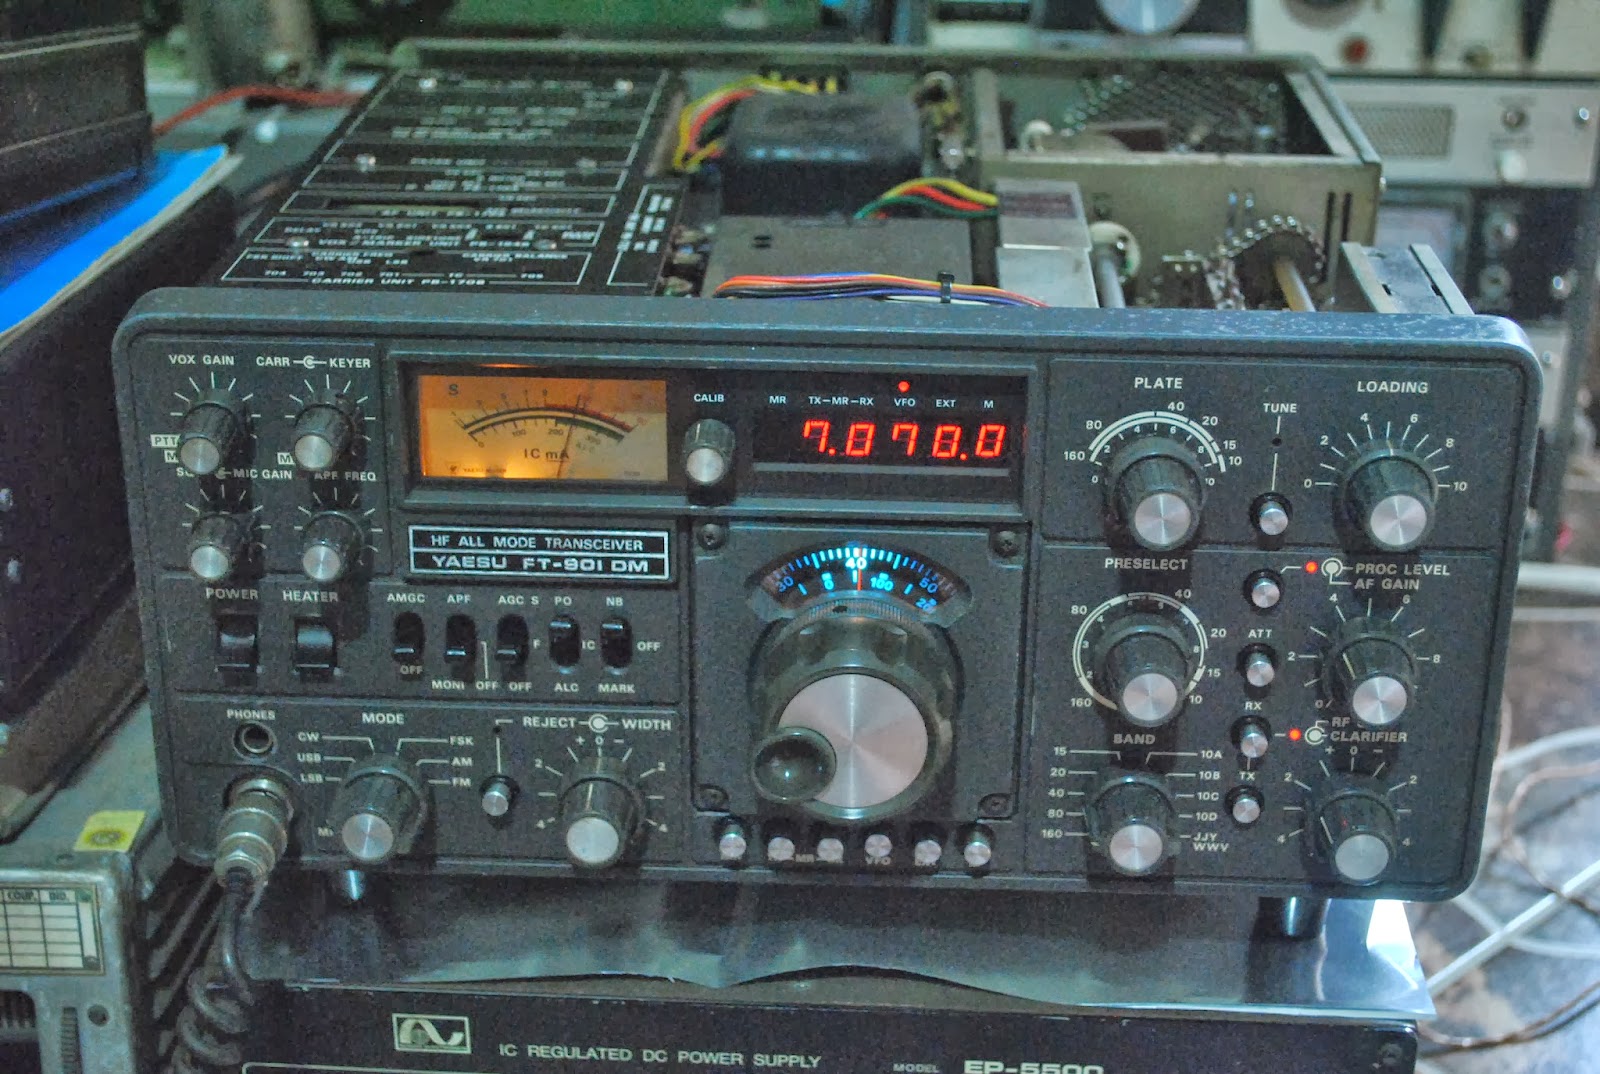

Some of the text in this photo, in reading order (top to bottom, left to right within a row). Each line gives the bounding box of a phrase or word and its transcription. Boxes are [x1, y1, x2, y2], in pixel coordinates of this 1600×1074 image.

[168, 354, 235, 366] VOX GAIN
[256, 356, 290, 367] CARR
[329, 358, 371, 369] KEYER
[1134, 377, 1183, 389] PLATE
[1357, 380, 1429, 394] LOADING
[448, 384, 459, 397] S
[694, 393, 724, 403] CALIB
[769, 395, 787, 404] MR
[894, 398, 916, 407] VFO
[936, 399, 956, 408] EXT
[984, 400, 994, 409] M
[1168, 401, 1185, 411] 40
[1263, 403, 1297, 413] TUNE
[1202, 416, 1218, 426] 20
[1360, 413, 1369, 423] 4
[1410, 413, 1419, 423] 6
[1086, 420, 1102, 430] 80
[1133, 426, 1141, 434] 4
[1170, 426, 1177, 434] 6
[154, 436, 177, 446] PTT
[1224, 440, 1237, 450] 15
[1320, 435, 1329, 446] 2
[1445, 438, 1454, 448] 8
[524, 447, 541, 459] IC
[1104, 445, 1111, 454] 2
[1063, 451, 1085, 461] 160
[1229, 456, 1242, 466] 10
[233, 469, 293, 481] MIC GAIN
[345, 471, 376, 482] FREQ
[1091, 475, 1098, 484] 0
[1303, 479, 1313, 489] 0
[1453, 481, 1468, 492] 10
[431, 534, 643, 551] HF ALL MODE TRANSCEIVER
[432, 555, 648, 573] YAESU FT-901 DM
[845, 557, 867, 570] 40
[1104, 558, 1188, 571] PRESELECT
[1355, 563, 1450, 576] PROC LEVEL
[775, 576, 794, 593] 30
[871, 577, 894, 592] 100
[919, 577, 939, 594] 50
[1354, 578, 1420, 590] AF GAIN
[206, 587, 258, 600] POWER
[283, 589, 338, 603] HEATER
[387, 593, 426, 604] AMGC
[1175, 589, 1192, 599] 40
[1329, 593, 1338, 603] 4
[447, 594, 471, 604] APF
[498, 595, 539, 605] AGC S
[554, 596, 572, 606] PO
[606, 597, 624, 607] NB
[1402, 595, 1411, 604] 6
[1071, 605, 1088, 616] 80
[1211, 628, 1227, 638] 20
[1248, 629, 1272, 638] ATT
[533, 639, 541, 649] F
[582, 640, 595, 650] IC
[637, 641, 661, 651] OFF
[1288, 652, 1296, 661] 2
[1433, 654, 1441, 663] 8
[400, 665, 423, 675] OFF
[1207, 668, 1221, 677] 15
[432, 681, 465, 691] MONI
[475, 681, 498, 691] OFF
[509, 681, 533, 691] OFF
[554, 682, 579, 693] ALC
[598, 683, 635, 694] MARK
[1070, 698, 1092, 708] 160
[1189, 695, 1203, 704] 10
[1245, 701, 1262, 710] RX
[227, 709, 275, 721] PHONES
[362, 713, 405, 725] MODE
[522, 716, 577, 728] REJECT
[622, 719, 672, 731] WIDTH
[1332, 717, 1350, 727] RF
[298, 732, 320, 742] CW
[449, 736, 474, 746] FSK
[595, 736, 604, 746] 0
[1113, 734, 1156, 745] BAND
[1330, 731, 1408, 743] CLARIFIER
[1054, 747, 1067, 756] 15
[1200, 750, 1223, 760] 10A
[297, 753, 321, 763] USB
[452, 757, 473, 767] AM
[534, 758, 543, 768] 2
[657, 762, 666, 772] 2
[1050, 768, 1067, 777] 20
[1199, 771, 1221, 780] 10B
[1239, 772, 1255, 781] TX
[1284, 773, 1292, 782] 2
[300, 774, 323, 783] LSB
[452, 778, 471, 788] FM
[1409, 775, 1418, 784] 2
[1048, 789, 1065, 798] 40
[1197, 791, 1219, 801] 10C
[1047, 809, 1064, 818] 80
[1196, 812, 1218, 821] 10D
[536, 820, 546, 829] 4
[1041, 830, 1063, 838] 160
[1193, 832, 1218, 842] JJY
[1277, 835, 1286, 844] 4
[1402, 838, 1411, 847] 4
[1192, 842, 1230, 853] WWV
[499, 1044, 822, 1069] IC REGULATED DC POWER SUPPLY
[893, 1059, 1104, 1074] MODEL EP-5500
